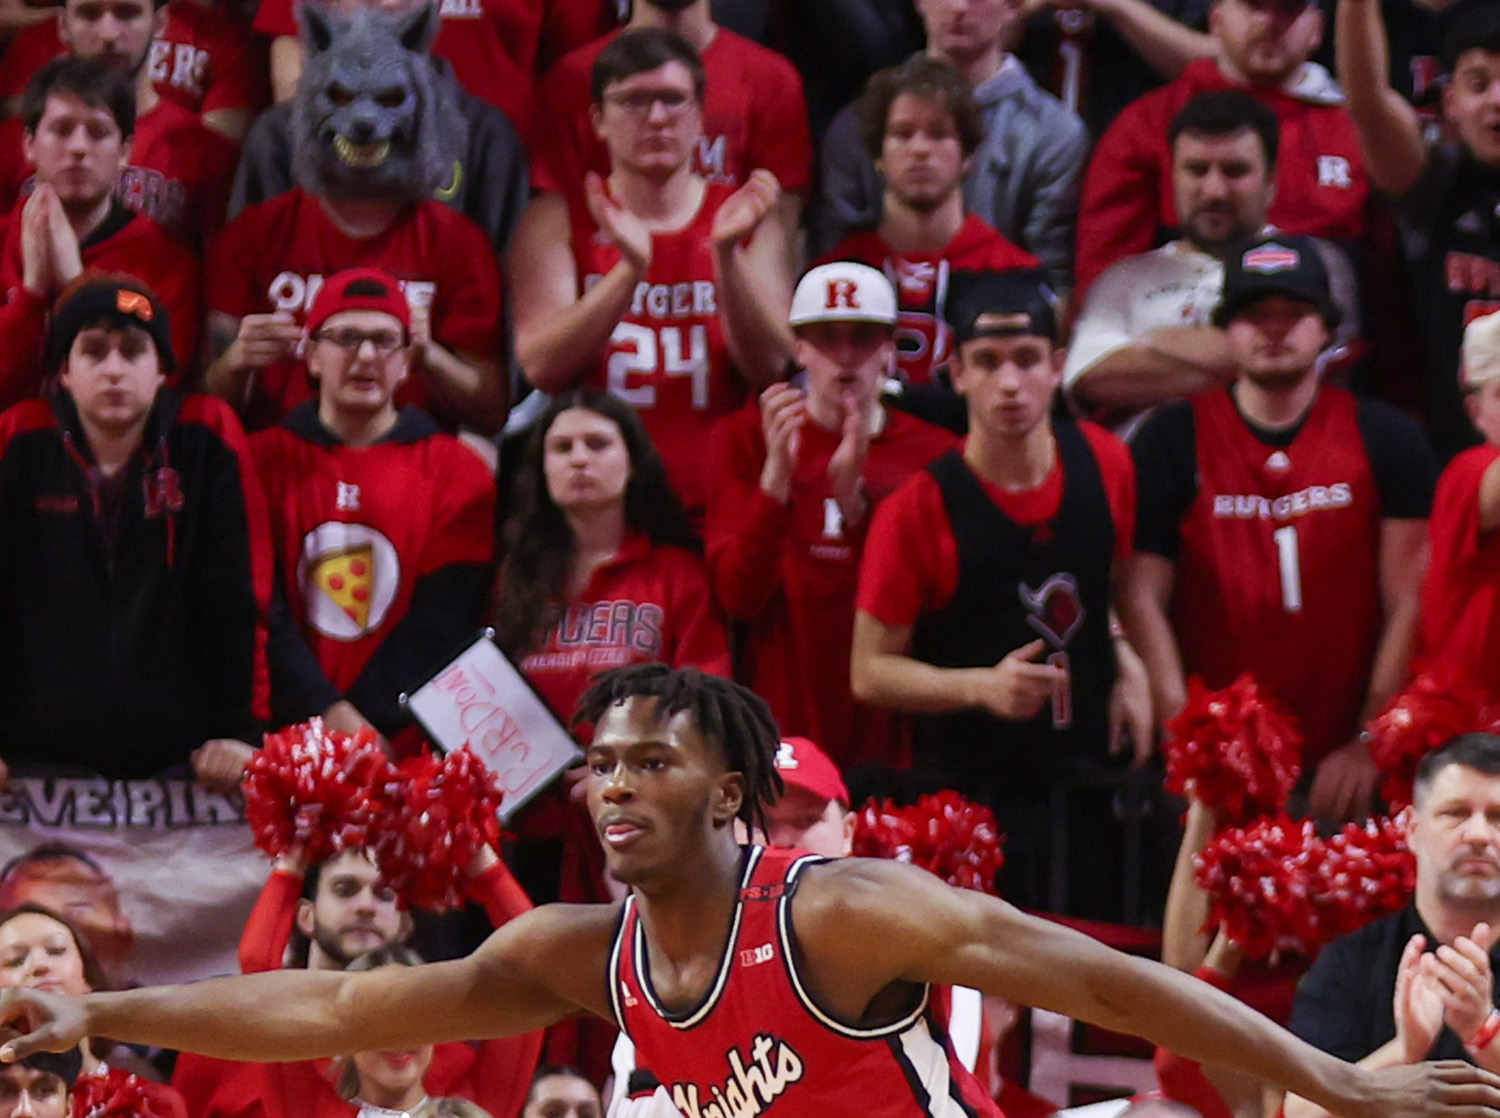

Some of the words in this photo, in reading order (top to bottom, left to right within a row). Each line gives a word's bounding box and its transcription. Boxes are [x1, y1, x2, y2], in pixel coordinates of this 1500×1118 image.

[825, 279, 860, 309] R
[607, 321, 708, 410] 24
[1214, 483, 1352, 519] RUTGERS
[1273, 525, 1303, 613] 1
